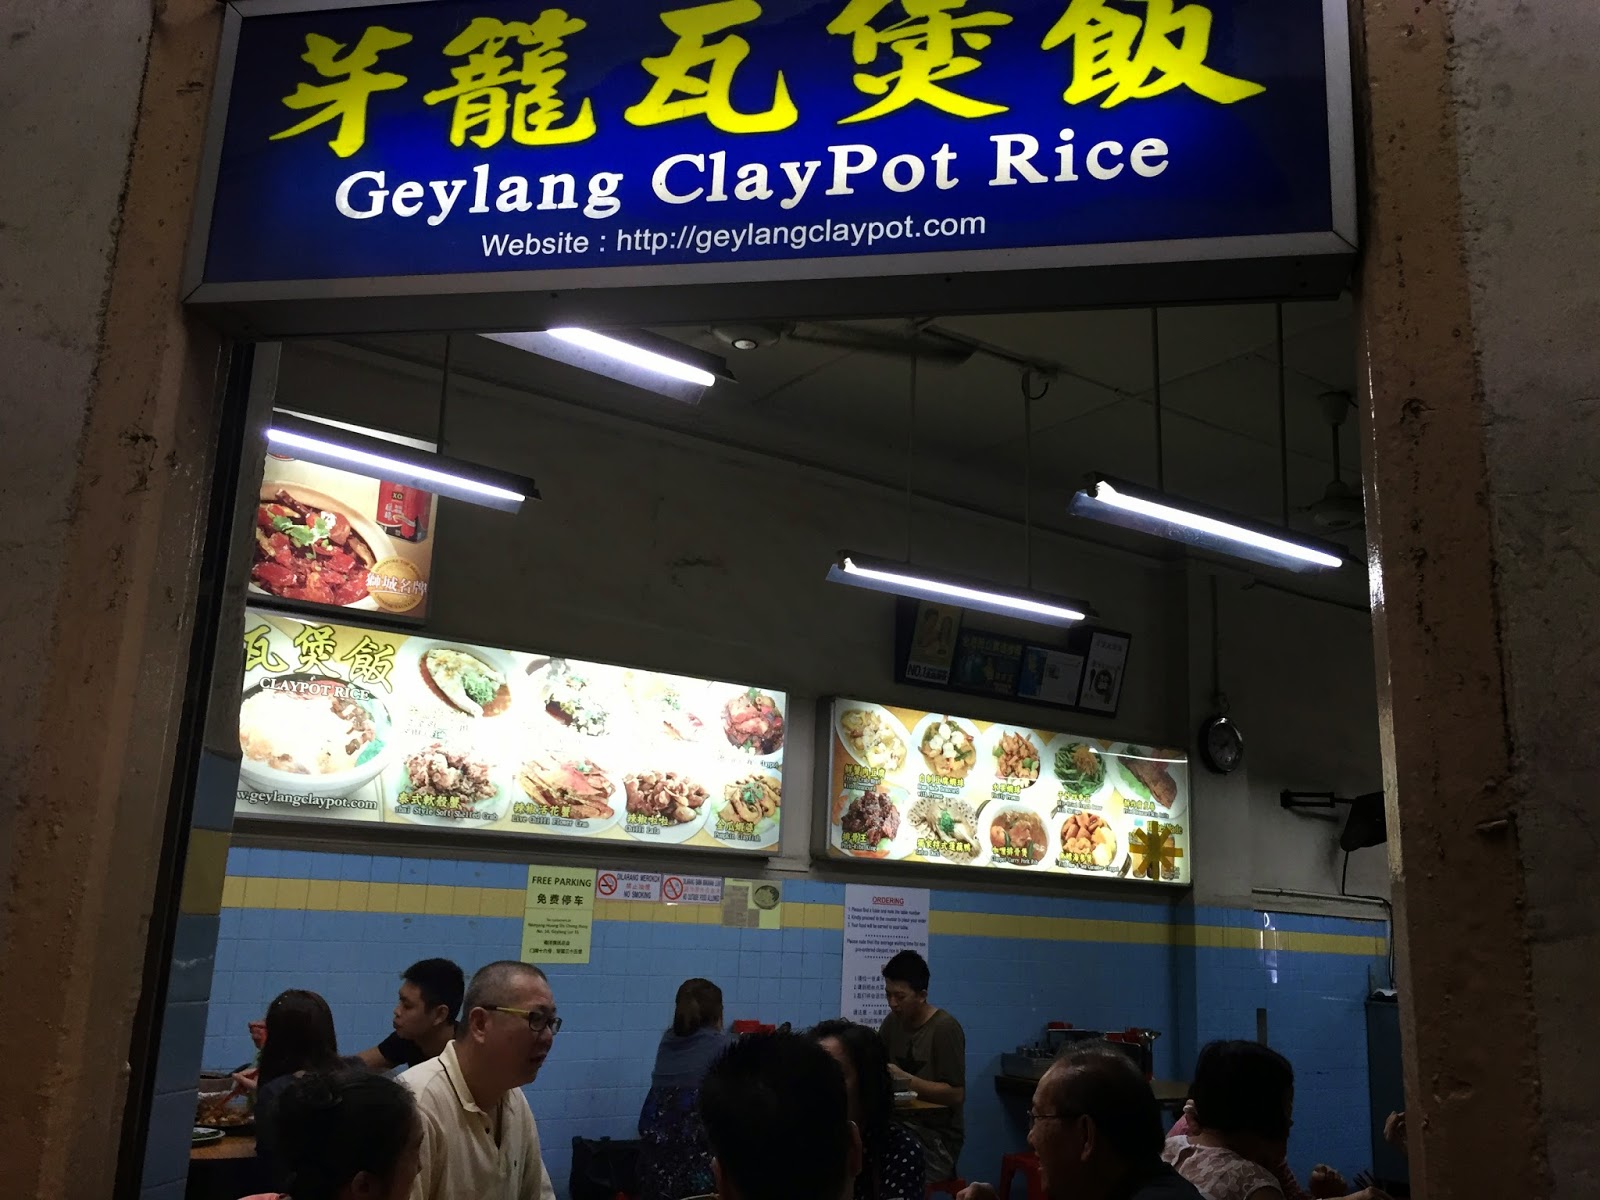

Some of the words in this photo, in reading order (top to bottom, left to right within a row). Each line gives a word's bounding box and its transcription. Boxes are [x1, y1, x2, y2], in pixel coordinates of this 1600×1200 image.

[335, 164, 623, 226] Geylang
[652, 143, 959, 209] ClayPot
[989, 129, 1169, 187] Rice
[481, 233, 589, 257] Website
[616, 214, 986, 256] http://geylangclaypot.com
[259, 676, 331, 697] CLAYPOT
[334, 686, 370, 702] RICE
[413, 806, 433, 816] Style
[435, 808, 451, 817] Soft
[453, 810, 481, 819] Shelled
[482, 812, 498, 821] Crab
[532, 876, 552, 885] FREE
[554, 877, 592, 887] PARKING
[617, 873, 639, 882] DILARANG
[537, 893, 584, 906] 免费停车
[624, 890, 630, 898] NO
[632, 891, 651, 899] SMOKING
[872, 896, 904, 906] ORDERING
